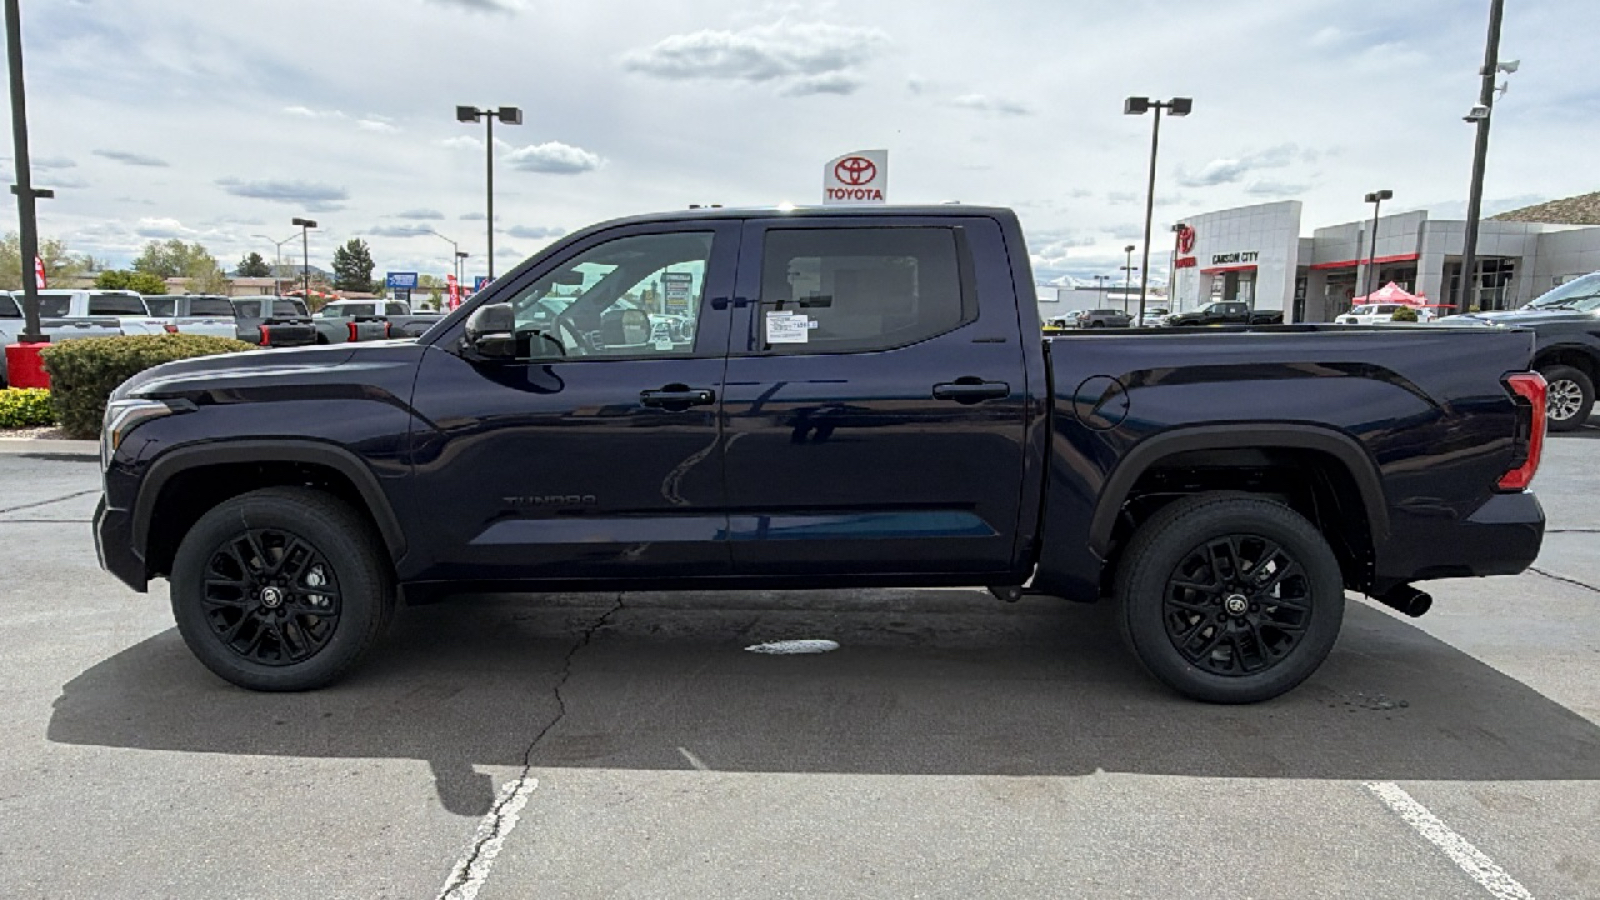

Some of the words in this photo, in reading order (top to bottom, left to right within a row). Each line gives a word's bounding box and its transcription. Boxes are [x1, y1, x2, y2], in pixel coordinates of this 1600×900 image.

[826, 188, 883, 201] TOYOTA
[1212, 252, 1240, 265] CARSON
[1241, 250, 1259, 262] CITY
[502, 494, 598, 506] TUNDRA
